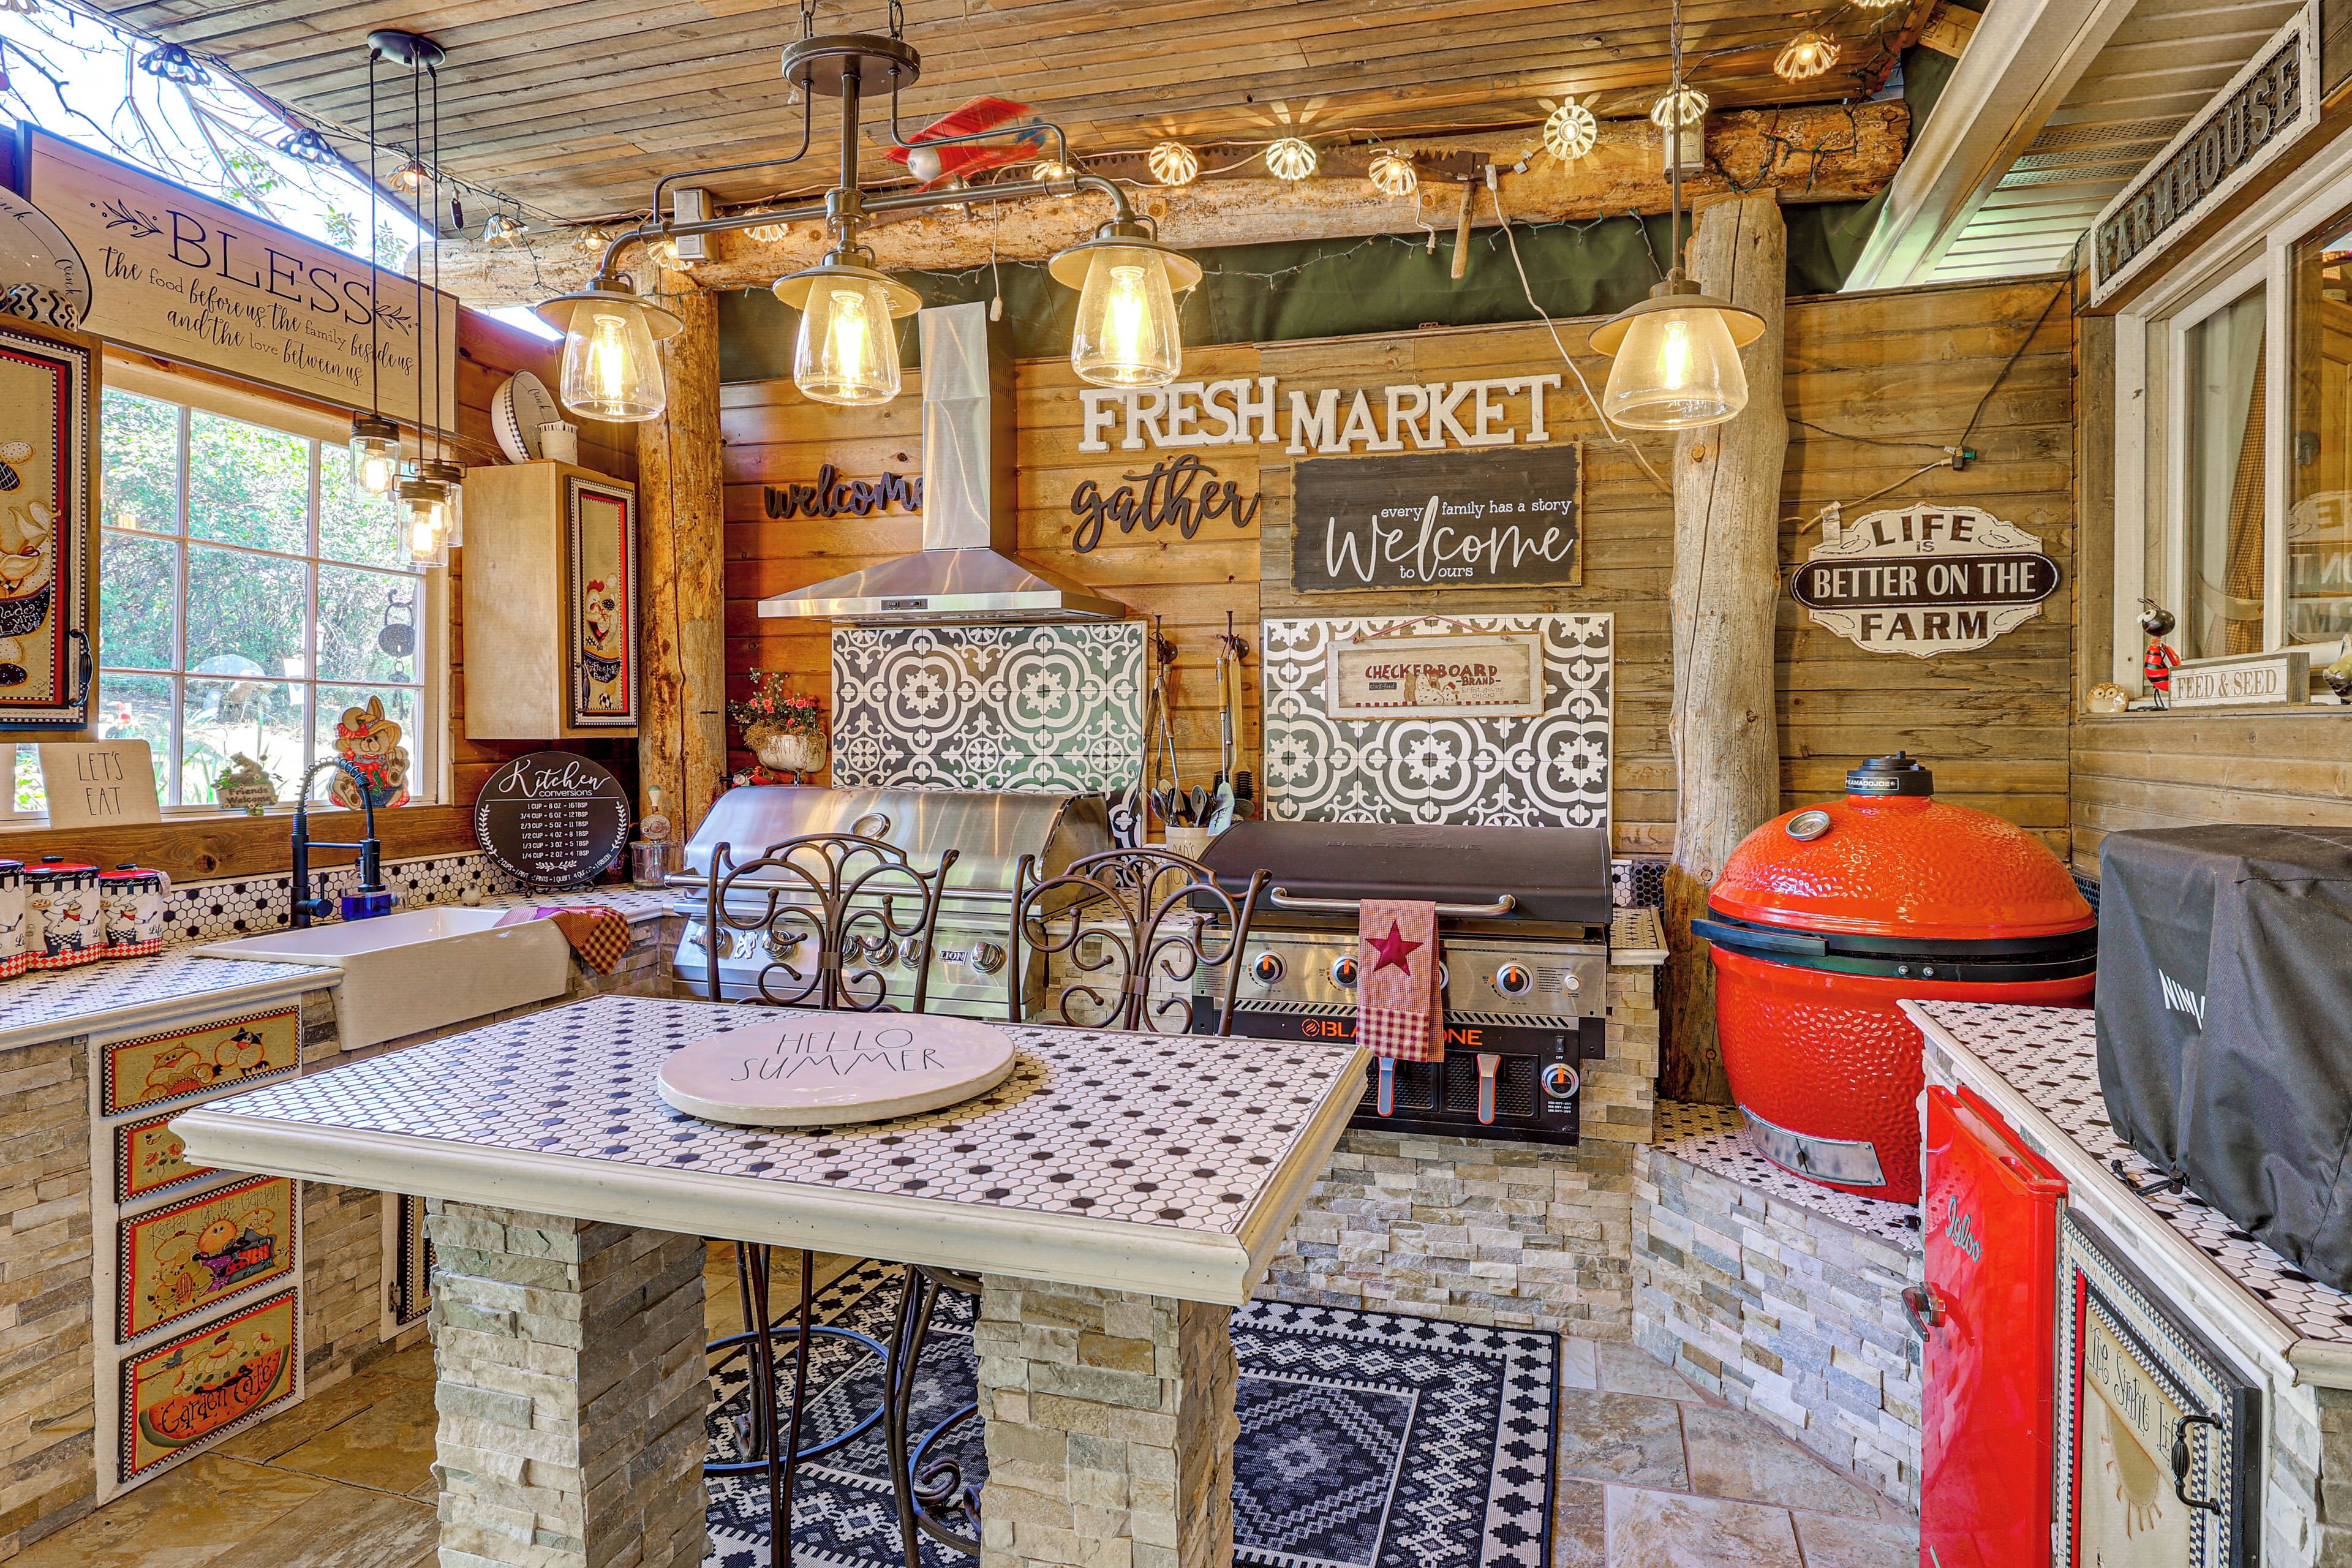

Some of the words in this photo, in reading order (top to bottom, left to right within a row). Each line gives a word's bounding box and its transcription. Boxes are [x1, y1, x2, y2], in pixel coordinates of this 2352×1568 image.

[2098, 40, 2301, 279] FARMHOUSE
[55, 259, 83, 295] Oink
[165, 209, 372, 325] BLESS
[99, 246, 143, 281] the
[148, 268, 184, 294] food
[189, 278, 244, 313] before
[267, 303, 301, 331] the
[305, 320, 346, 351] family
[351, 333, 396, 368] besde
[398, 356, 413, 375] us
[167, 309, 210, 339] and
[208, 317, 244, 346] the
[249, 332, 278, 355] love
[284, 339, 344, 377] between
[1078, 376, 1279, 452] FRESH
[1286, 374, 1561, 455] MARKET
[764, 464, 924, 519] welcome
[1070, 453, 1261, 554] gather
[1381, 506, 1424, 521] every
[1442, 501, 1485, 519] family
[1489, 500, 1513, 514] has
[1518, 503, 1526, 513] a
[1532, 499, 1572, 516] story
[1327, 495, 1574, 582] Welcome
[1871, 514, 1975, 547] LIFE
[1917, 541, 1935, 552] IS
[1400, 566, 1414, 579] to
[1438, 567, 1473, 578] ours
[1814, 566, 1917, 598] BETTER
[1927, 564, 1969, 595] ON
[1977, 562, 2036, 594] THE
[1861, 611, 1989, 641] FARM
[2177, 674, 2214, 699] FEED
[2218, 673, 2230, 697] &
[2233, 669, 2277, 695] SEED
[77, 751, 123, 781] LET'S
[499, 760, 611, 797] Kitchen
[86, 787, 121, 815] EAT
[228, 786, 268, 796] Friends
[940, 951, 964, 960] LION
[777, 1028, 913, 1055] HELLO
[731, 1048, 944, 1081] SUMMER
[241, 1185, 280, 1211] Garden
[1945, 1195, 1982, 1263] Igloo
[162, 1387, 227, 1433] Garden
